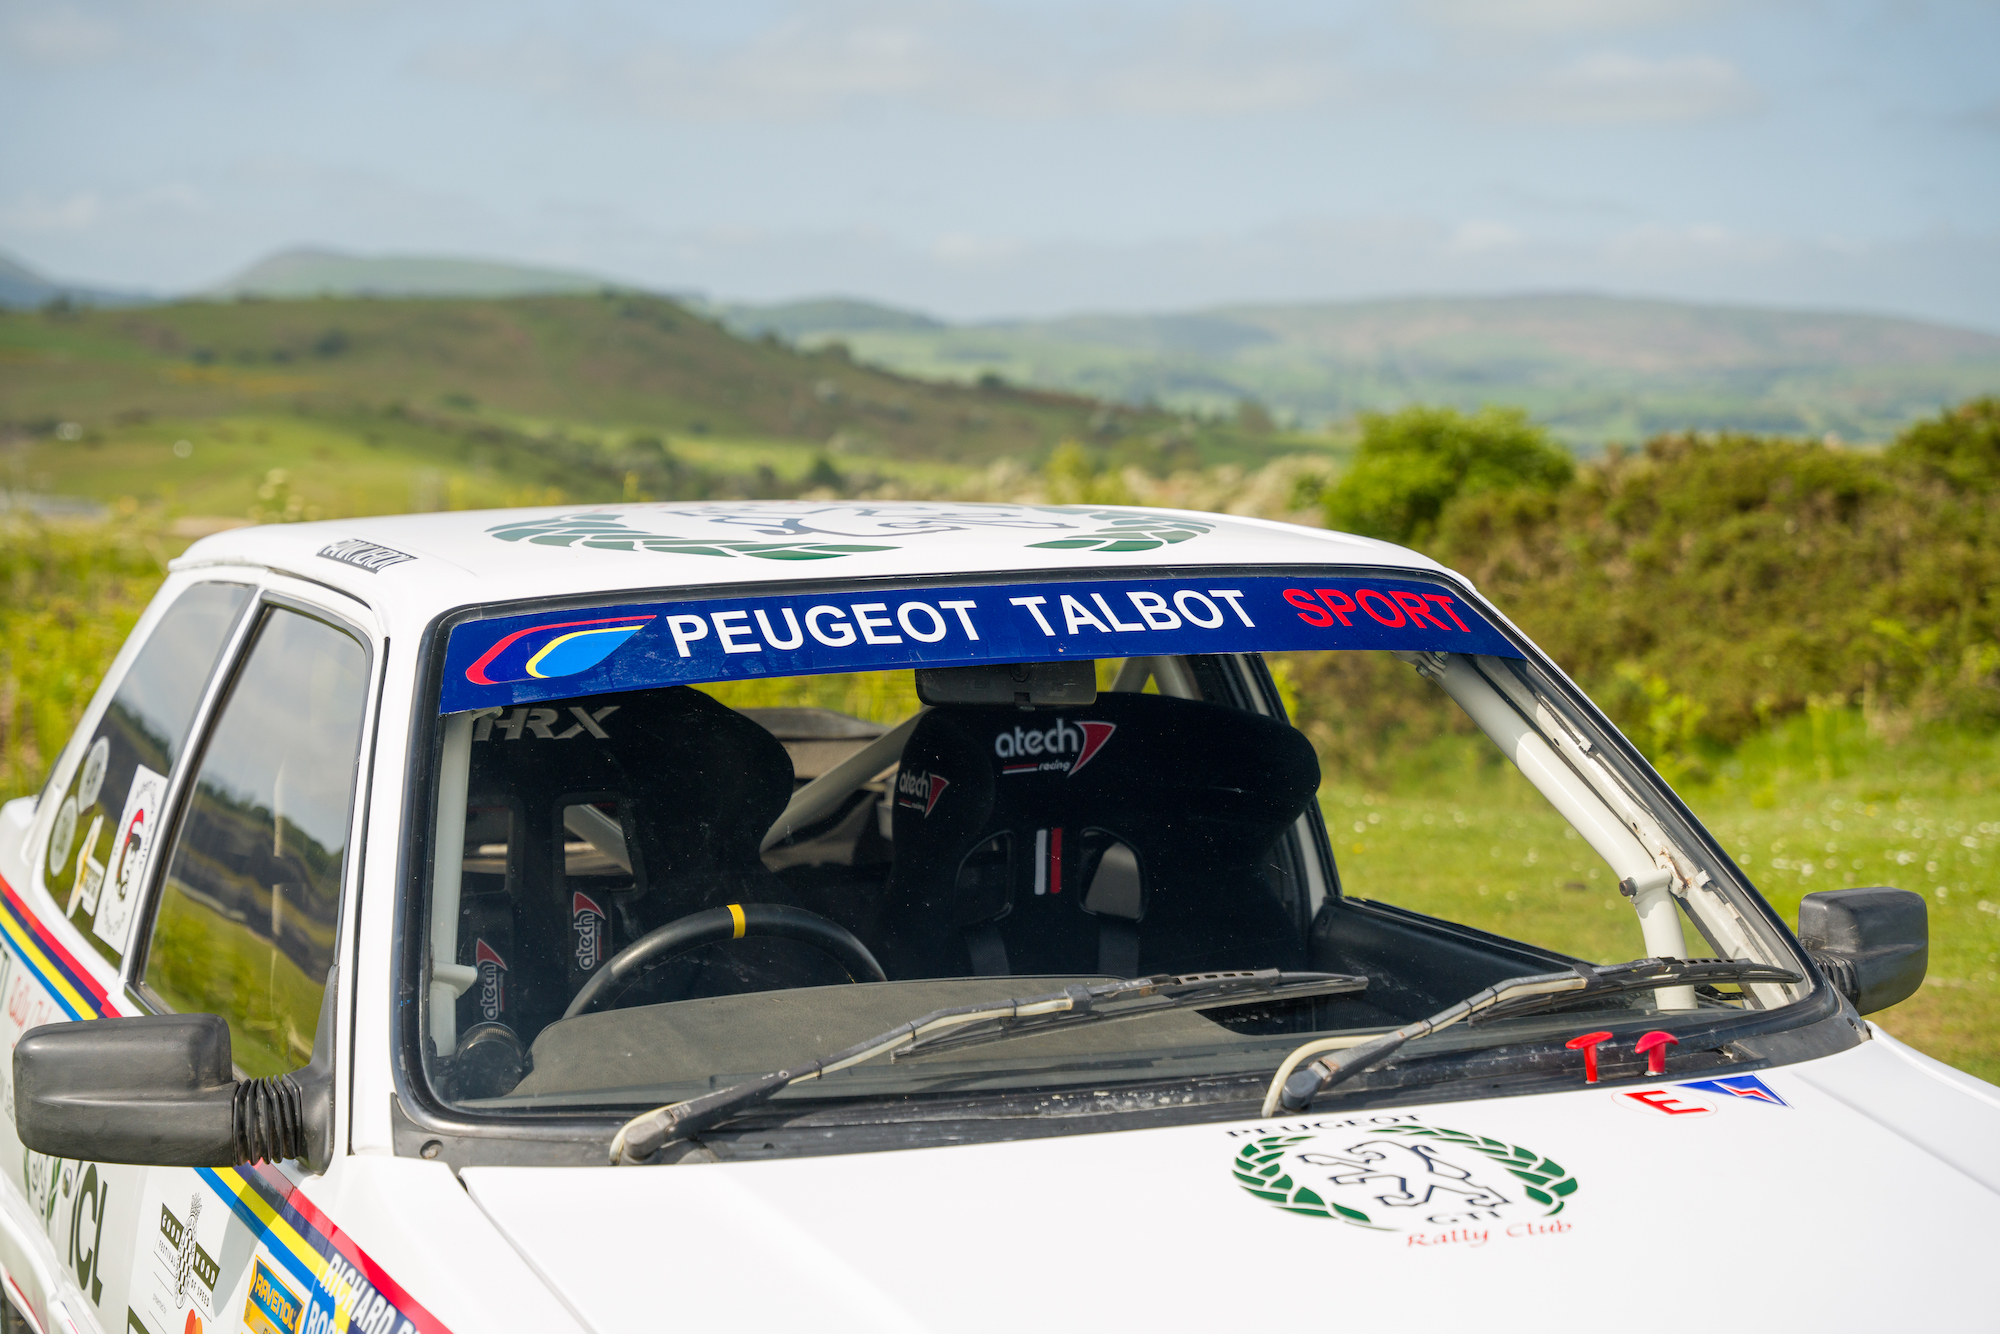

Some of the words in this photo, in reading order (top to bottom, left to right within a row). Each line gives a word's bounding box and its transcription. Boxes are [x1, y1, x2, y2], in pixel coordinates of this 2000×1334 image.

[666, 600, 980, 658] PEUGEOT
[1009, 589, 1256, 637] TALBOT
[1282, 588, 1471, 633] SPORT
[994, 717, 1079, 758] atech
[1039, 760, 1071, 772] racing
[899, 769, 929, 799] atech
[573, 912, 596, 971] atech
[1622, 1090, 1711, 1115] E
[1226, 1113, 1422, 1139] PEUGEOT
[1407, 1228, 1489, 1249] Rally
[1505, 1219, 1573, 1238] Club
[1425, 1210, 1502, 1226] GTI
[161, 1213, 181, 1244] GOOD
[194, 1251, 216, 1285] WOOD
[254, 1272, 295, 1331] RAVENOL
[319, 1252, 397, 1334] RICHARD
